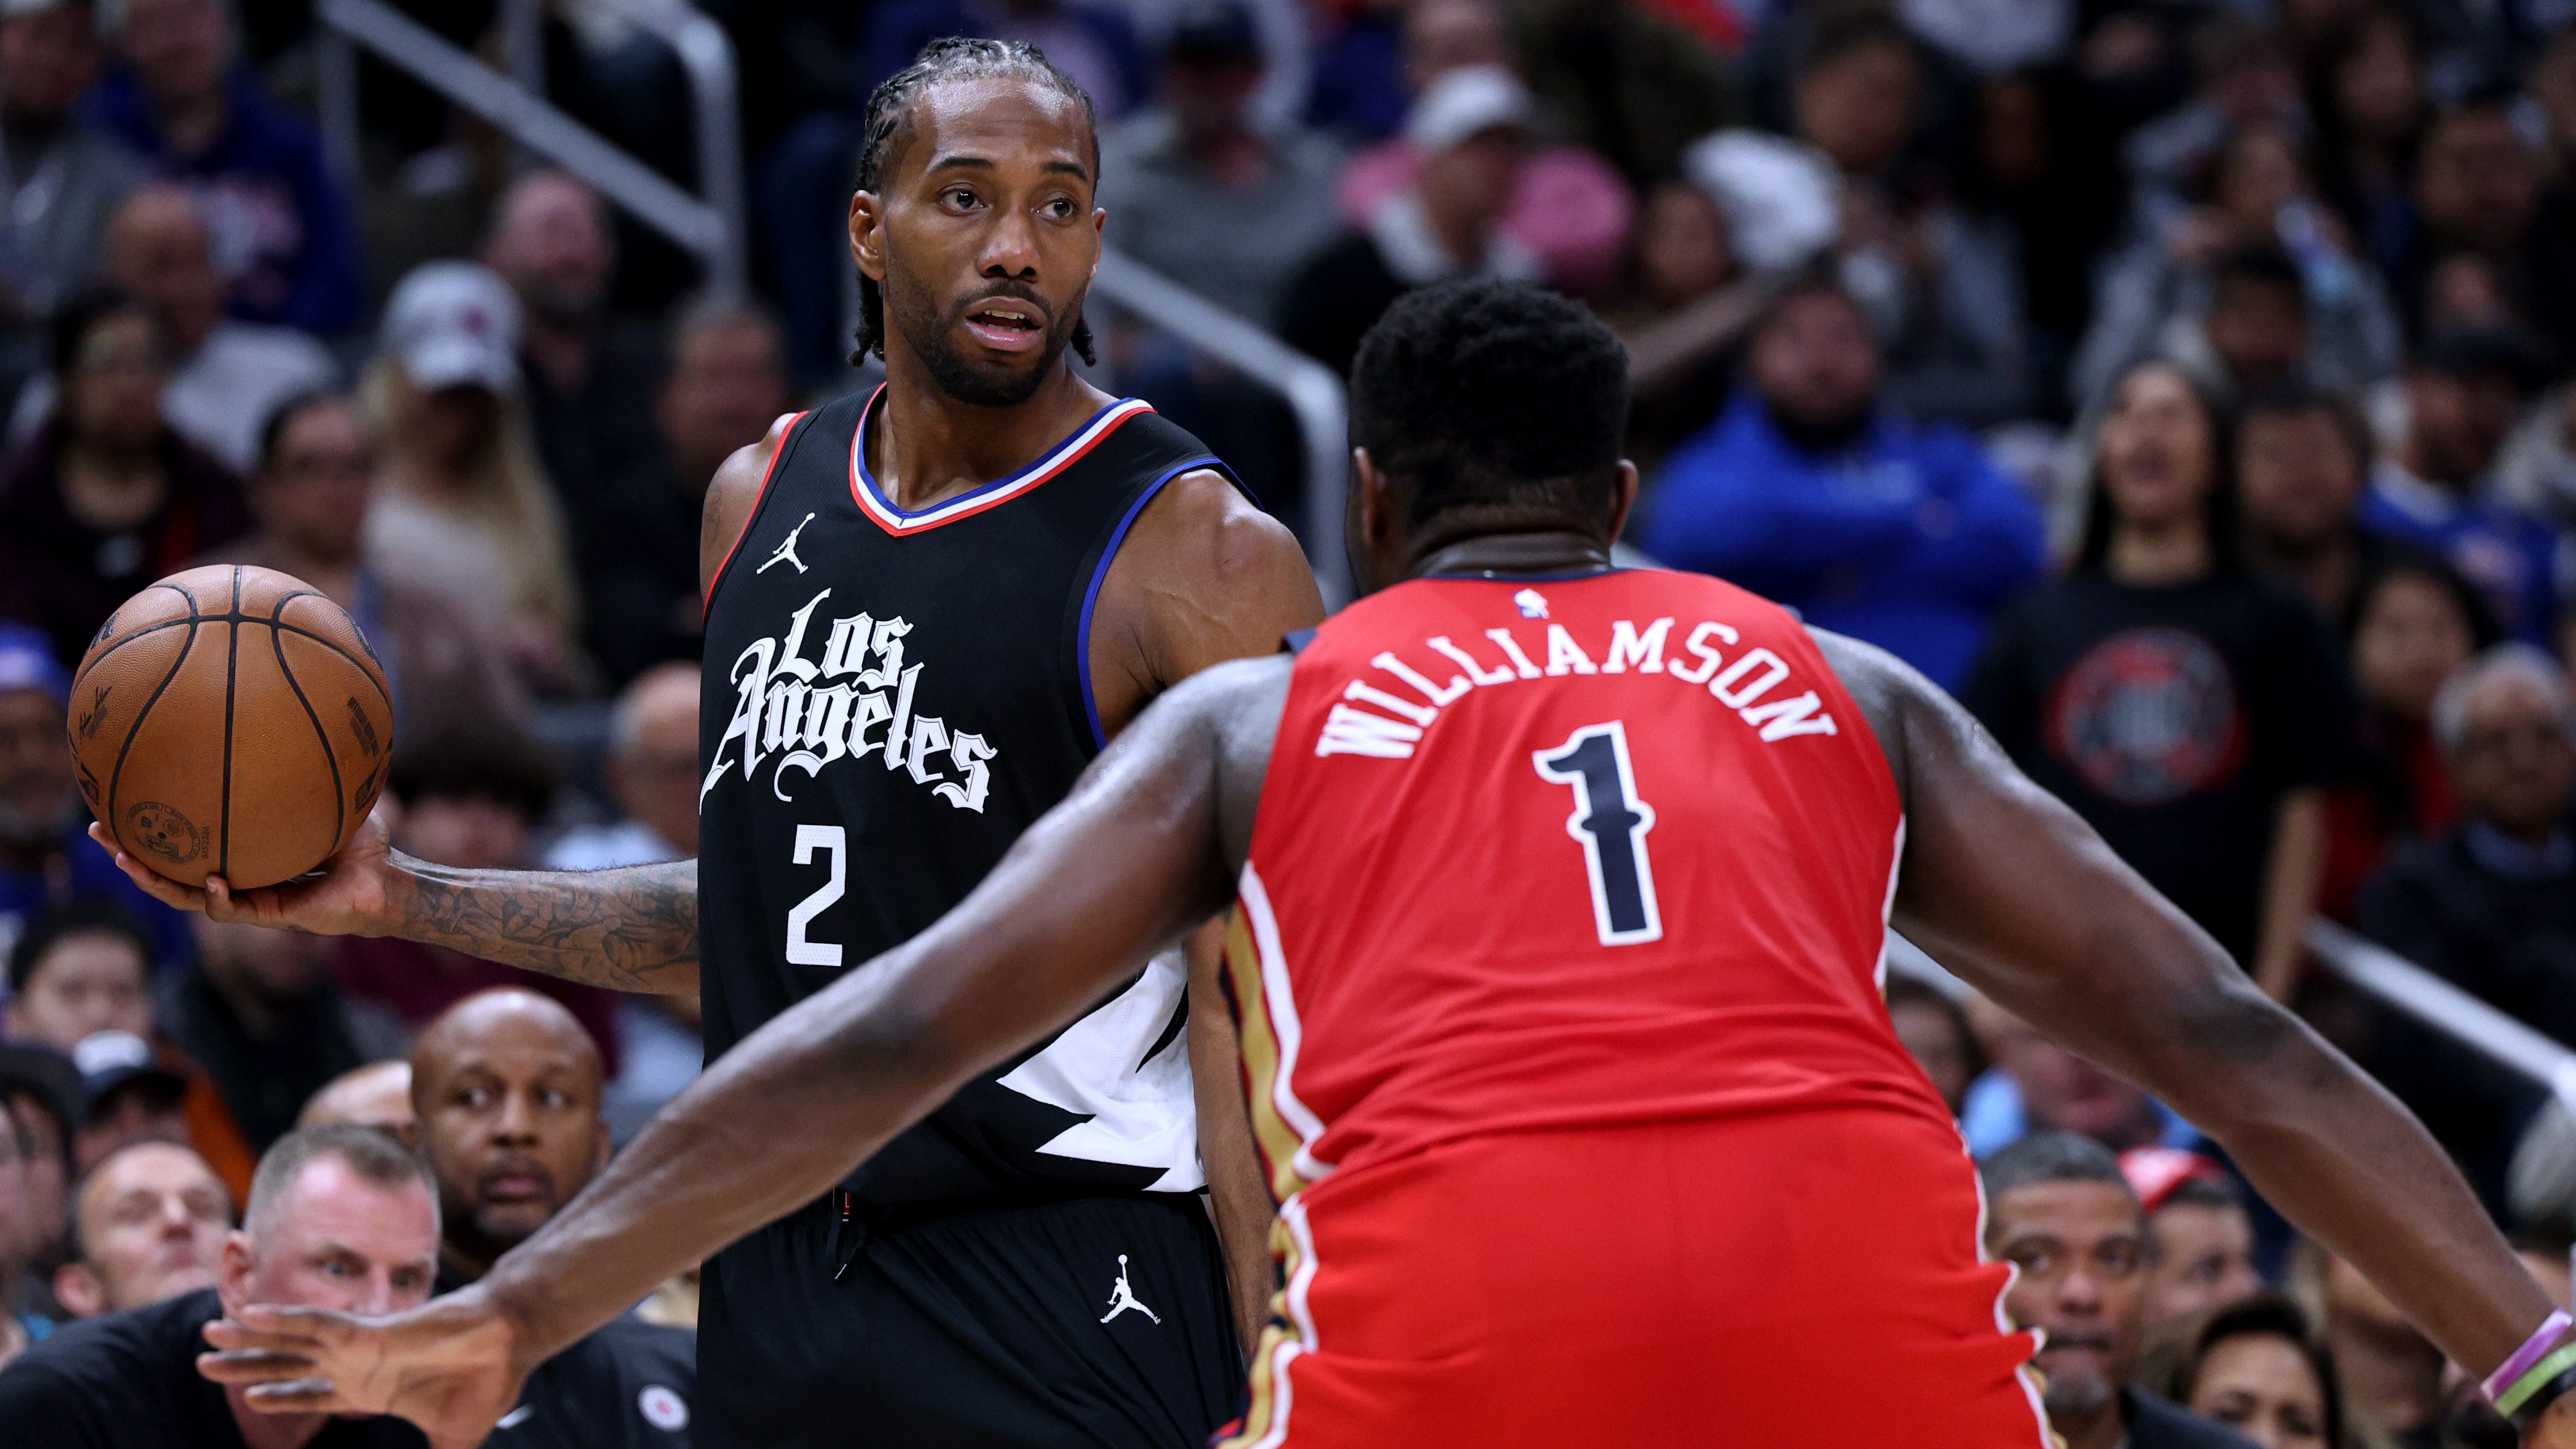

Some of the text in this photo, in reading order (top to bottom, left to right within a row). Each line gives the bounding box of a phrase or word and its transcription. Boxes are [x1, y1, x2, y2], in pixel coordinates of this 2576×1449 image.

[767, 587, 914, 691] Los
[1315, 616, 1837, 759] WILLIAMSON
[699, 637, 999, 816] Angeles
[785, 824, 846, 967] 2
[1532, 720, 1663, 946] 1
